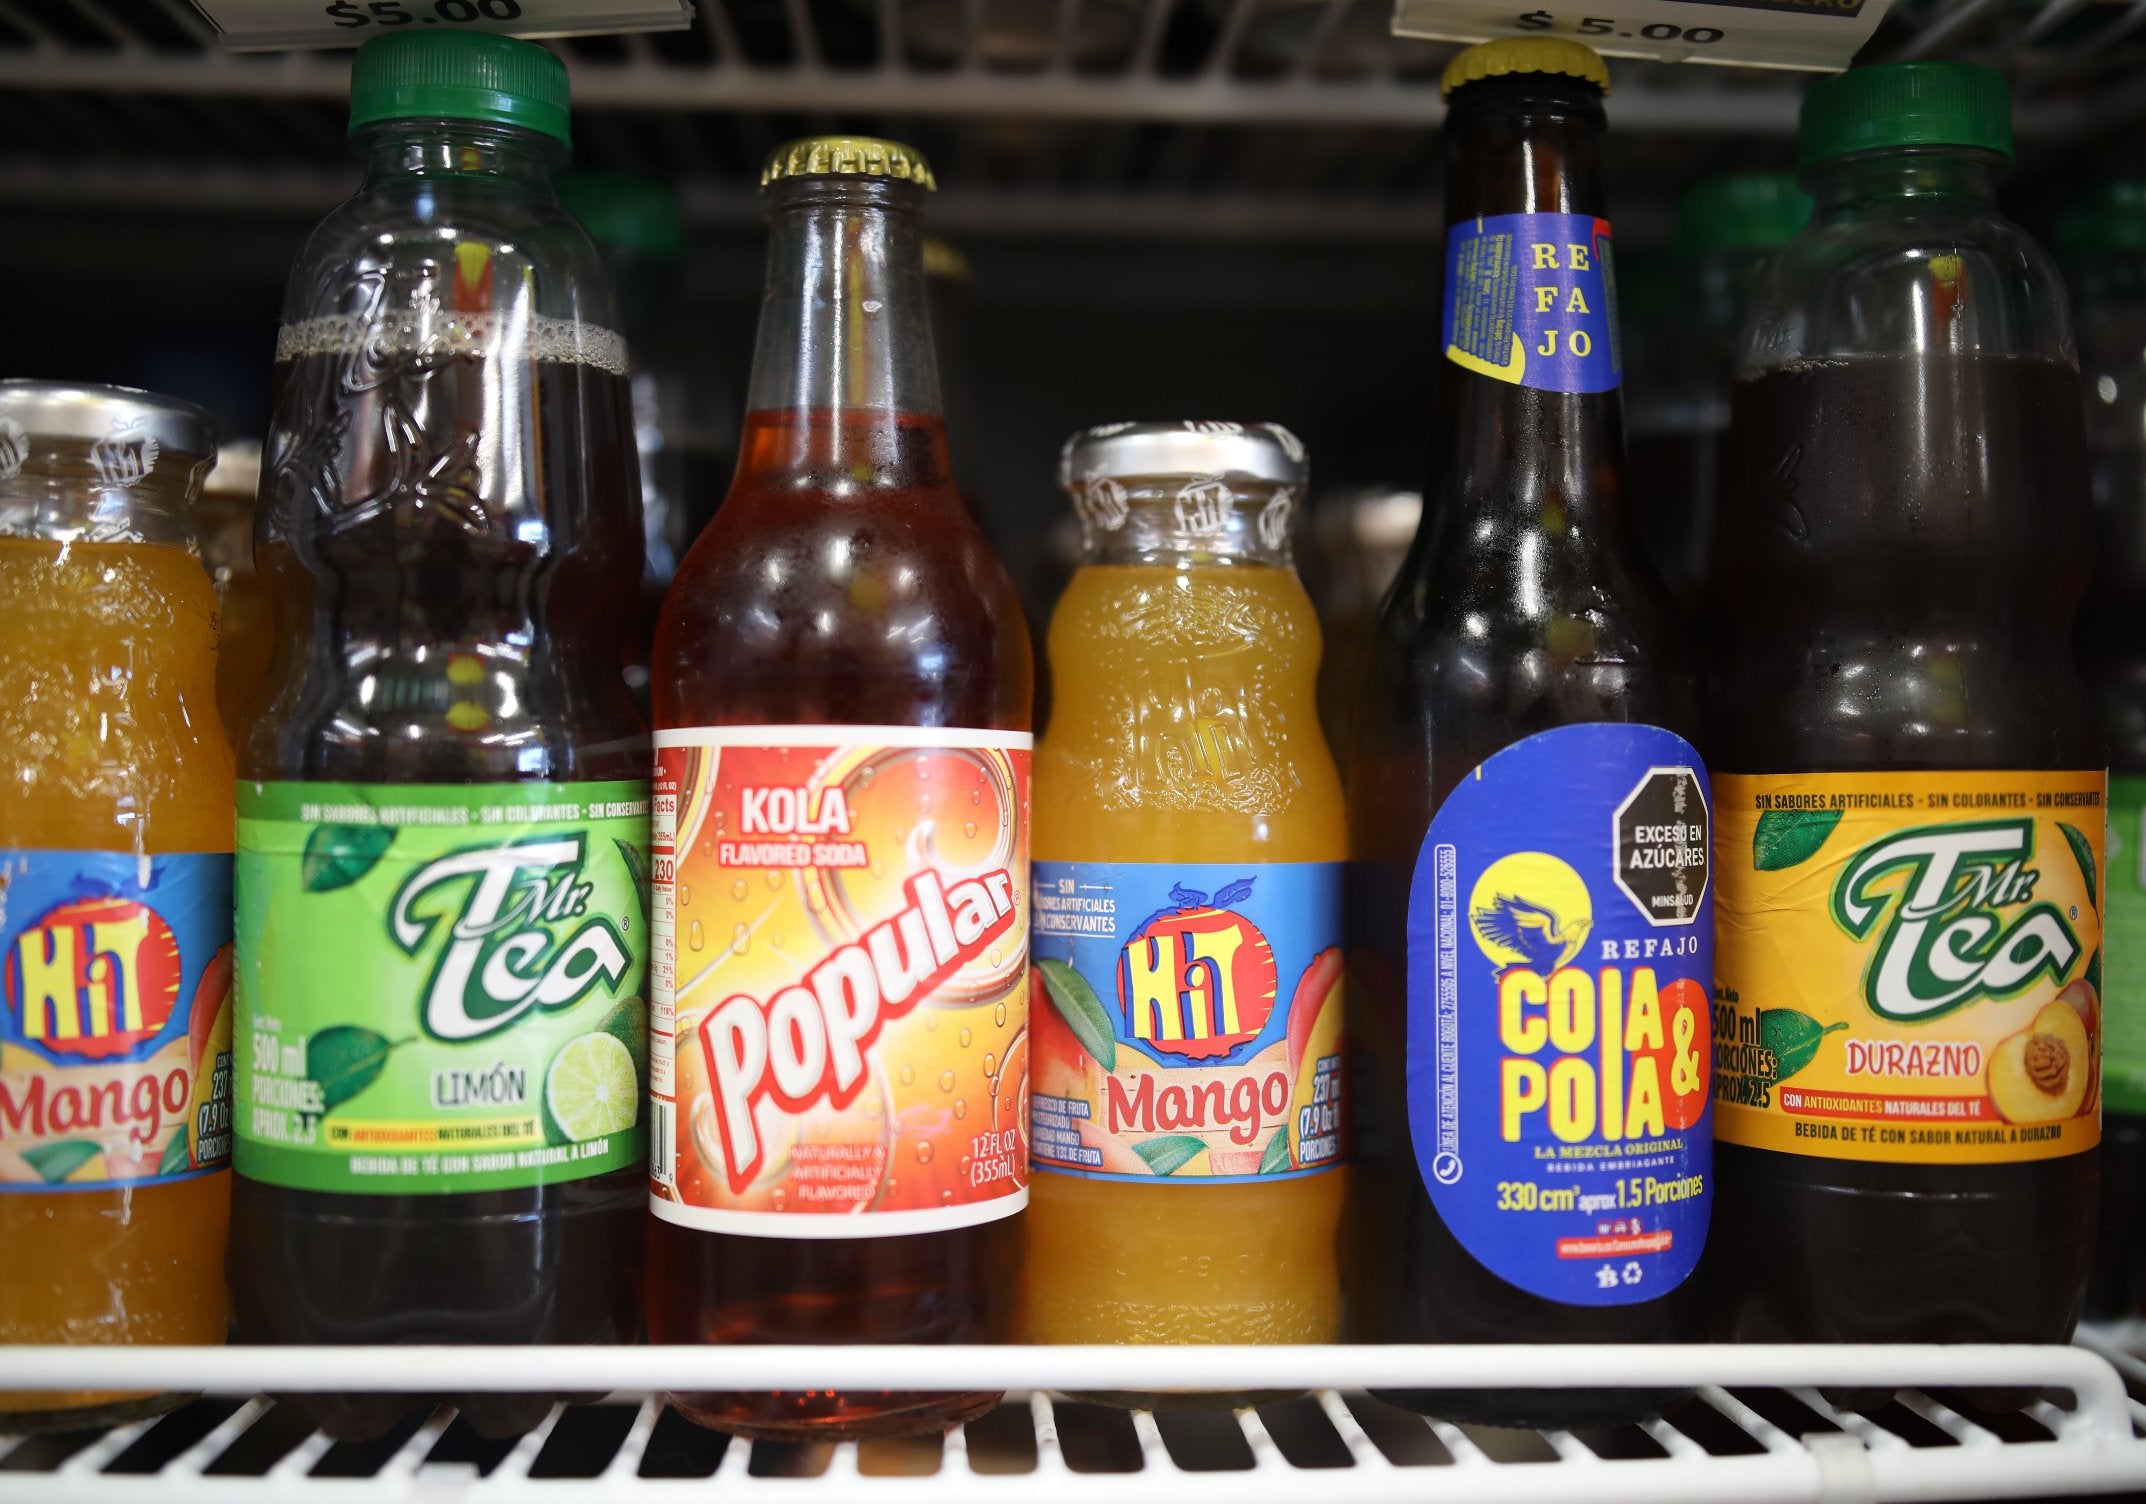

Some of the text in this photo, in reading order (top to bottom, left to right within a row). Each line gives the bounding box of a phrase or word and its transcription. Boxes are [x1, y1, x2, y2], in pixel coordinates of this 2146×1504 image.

[325, 0, 522, 28] $5.00
[1577, 17, 1725, 44] 5.00
[589, 802, 604, 819] SIN
[742, 787, 850, 834] KOLA
[1755, 794, 1771, 809] SIN
[1775, 794, 1826, 809] SABORES
[1830, 793, 1914, 809] ARTIFICIALES
[1928, 793, 1949, 807] SIN
[1953, 792, 2026, 808] COLORANTES
[2037, 792, 2052, 807] SIN
[1635, 824, 1702, 844] EXCESO EN
[720, 843, 867, 866] FLAVORED SODA
[1629, 843, 1705, 870] AZÚCARES
[655, 859, 674, 880] 230
[1059, 879, 1075, 894] SIN
[1061, 897, 1116, 913] ARTIFICIALES
[1652, 893, 1694, 908] MINSALUD
[1047, 914, 1116, 932] CONSERVANTES
[1601, 936, 1699, 960] REFAJO
[702, 867, 1014, 1184] Popular
[1739, 1006, 1761, 1046] ml
[1671, 1007, 1700, 1096] &
[1717, 1043, 1778, 1080] ORCIONES:
[1847, 1041, 1981, 1077] DURAZNO
[213, 1070, 228, 1100] 237
[434, 1060, 526, 1106] LIMÓN
[1313, 1073, 1330, 1103] 237
[1748, 1080, 1771, 1109] 2.5
[0, 1068, 189, 1145] Mango
[1068, 1101, 1089, 1117] FRUTA
[1107, 1071, 1289, 1146] Mango
[1784, 1093, 1981, 1117] CON ANTIOXIDANTES NATURALES DEL TÉ
[1299, 1106, 1320, 1139] (7.9
[1795, 1122, 2062, 1145] BEBIDA DE TÉ CON SABOR NATURAL A DURAZNO
[971, 1129, 1016, 1159] 12 FL OZ
[1056, 1130, 1080, 1146] MANGO
[1534, 1138, 1684, 1160] LA MEZCLA ORIGINAL
[517, 1145, 570, 1168] NATURAL
[570, 1146, 579, 1161] A
[581, 1137, 610, 1156] LIMÓN
[789, 1144, 873, 1161] NATURALLY
[1069, 1147, 1078, 1161] DE
[1079, 1149, 1101, 1164] FRUTA
[1546, 1155, 1676, 1174] BEBIDA EMBRIAGANTE
[791, 1164, 883, 1181] ARTIFICIALLY
[970, 1152, 1016, 1188] (355mL)
[798, 1184, 876, 1201] FLAVORED
[1497, 1181, 1538, 1212] 330
[1579, 1194, 1617, 1216] aprox
[1615, 1178, 1645, 1209] 1.5
[1645, 1172, 1704, 1206] Porciones
